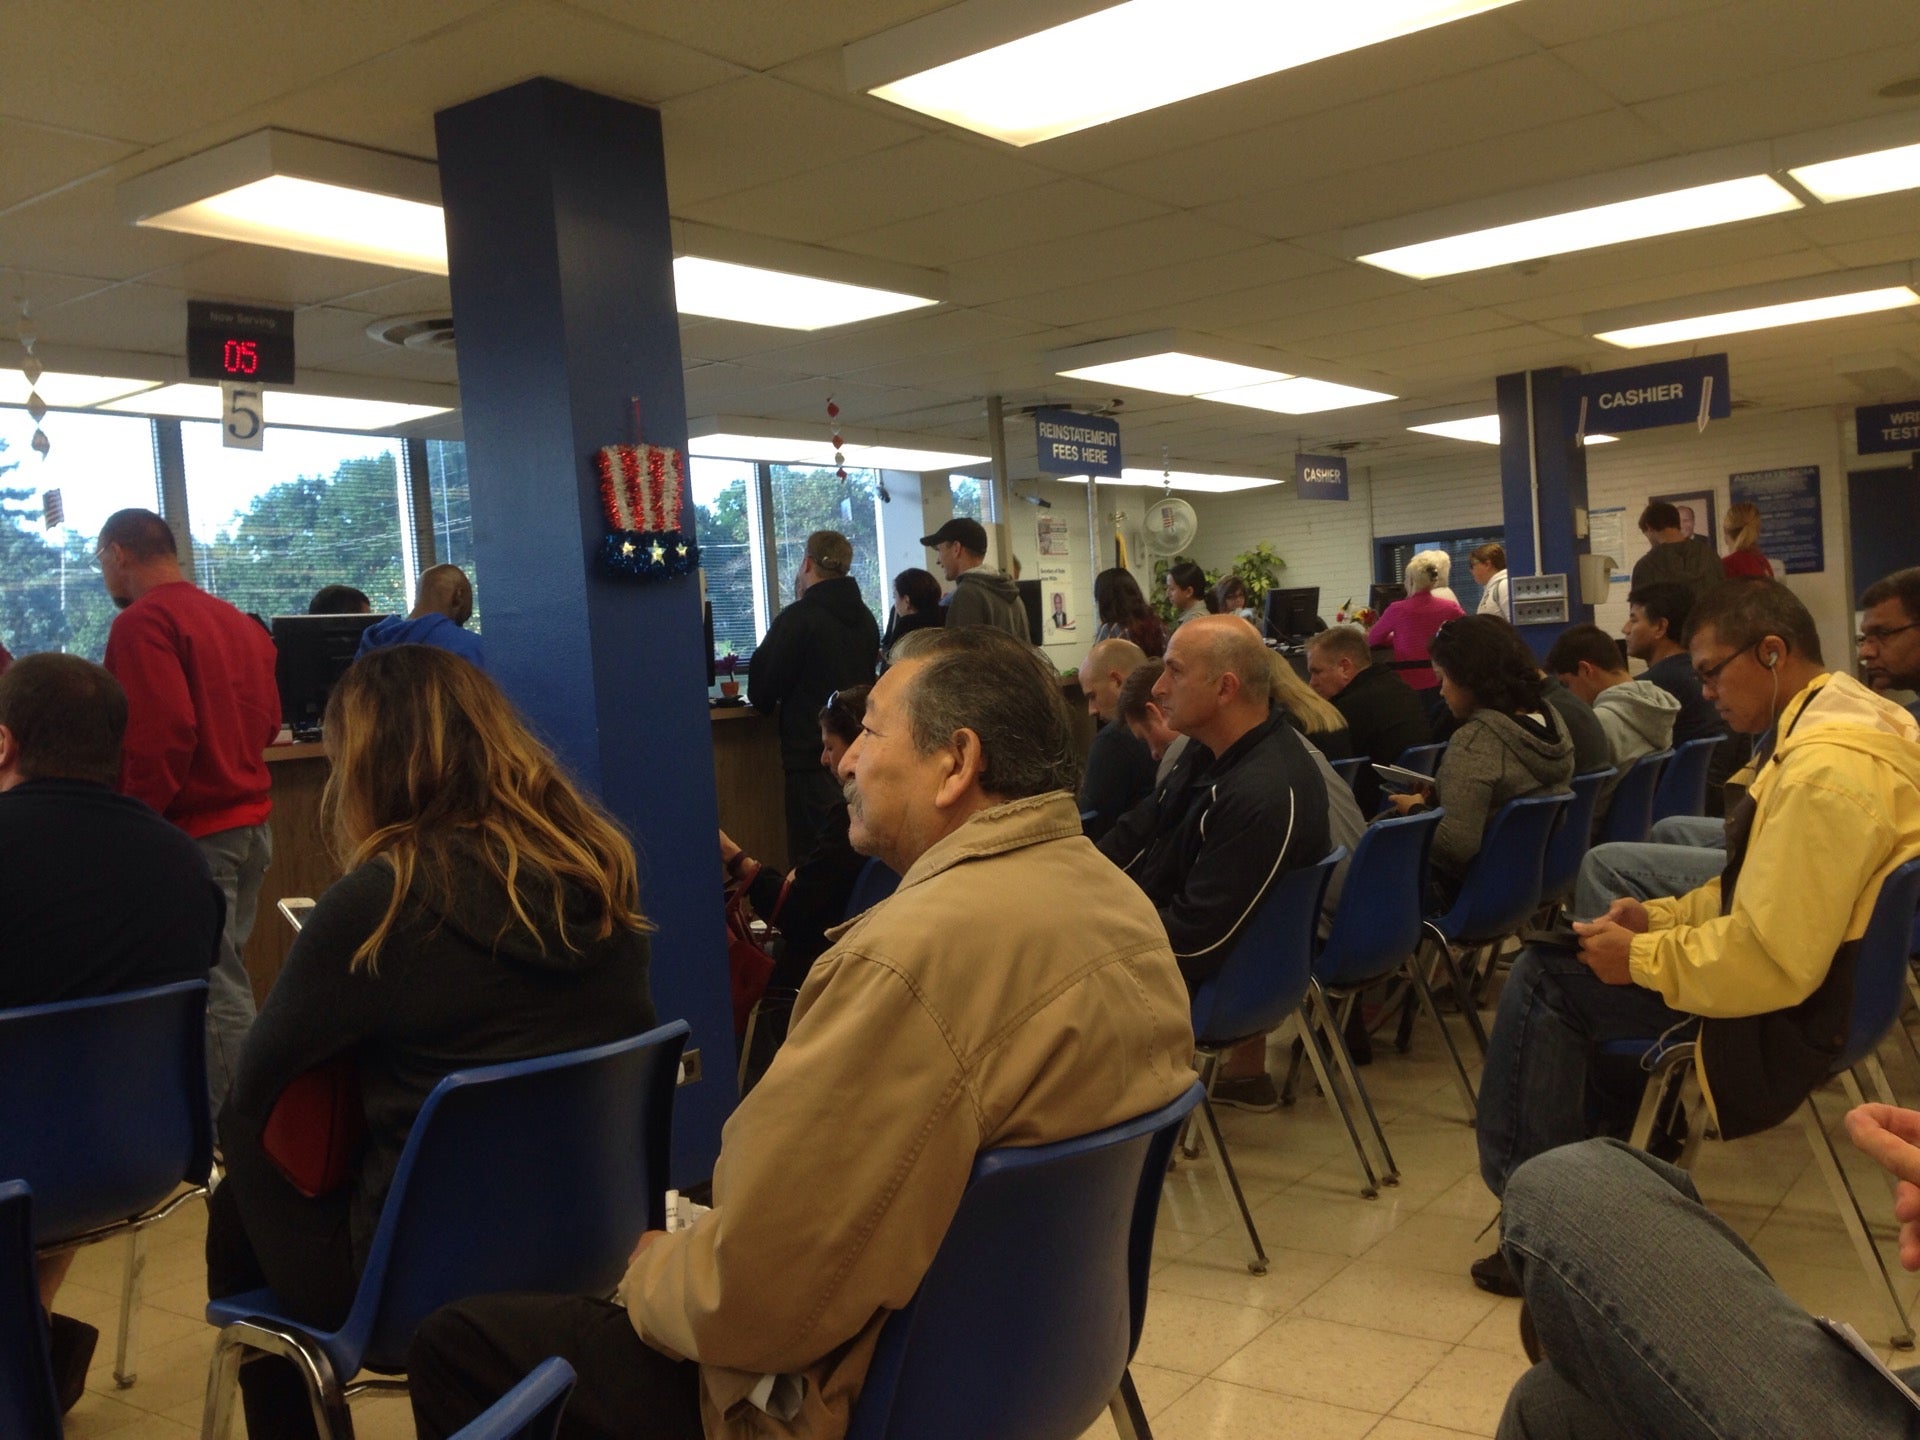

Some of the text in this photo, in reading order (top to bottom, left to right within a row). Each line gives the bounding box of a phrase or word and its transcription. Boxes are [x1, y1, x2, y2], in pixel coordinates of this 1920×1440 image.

[210, 312, 275, 329] Now Serving
[224, 340, 257, 373] 05
[1599, 383, 1683, 409] CASHIER
[228, 390, 259, 439] 5
[1039, 422, 1117, 447] REINSTATEMENT
[1882, 427, 1919, 440] TEST
[1053, 443, 1108, 464] FEES HERE
[1304, 467, 1341, 484] CASHIER
